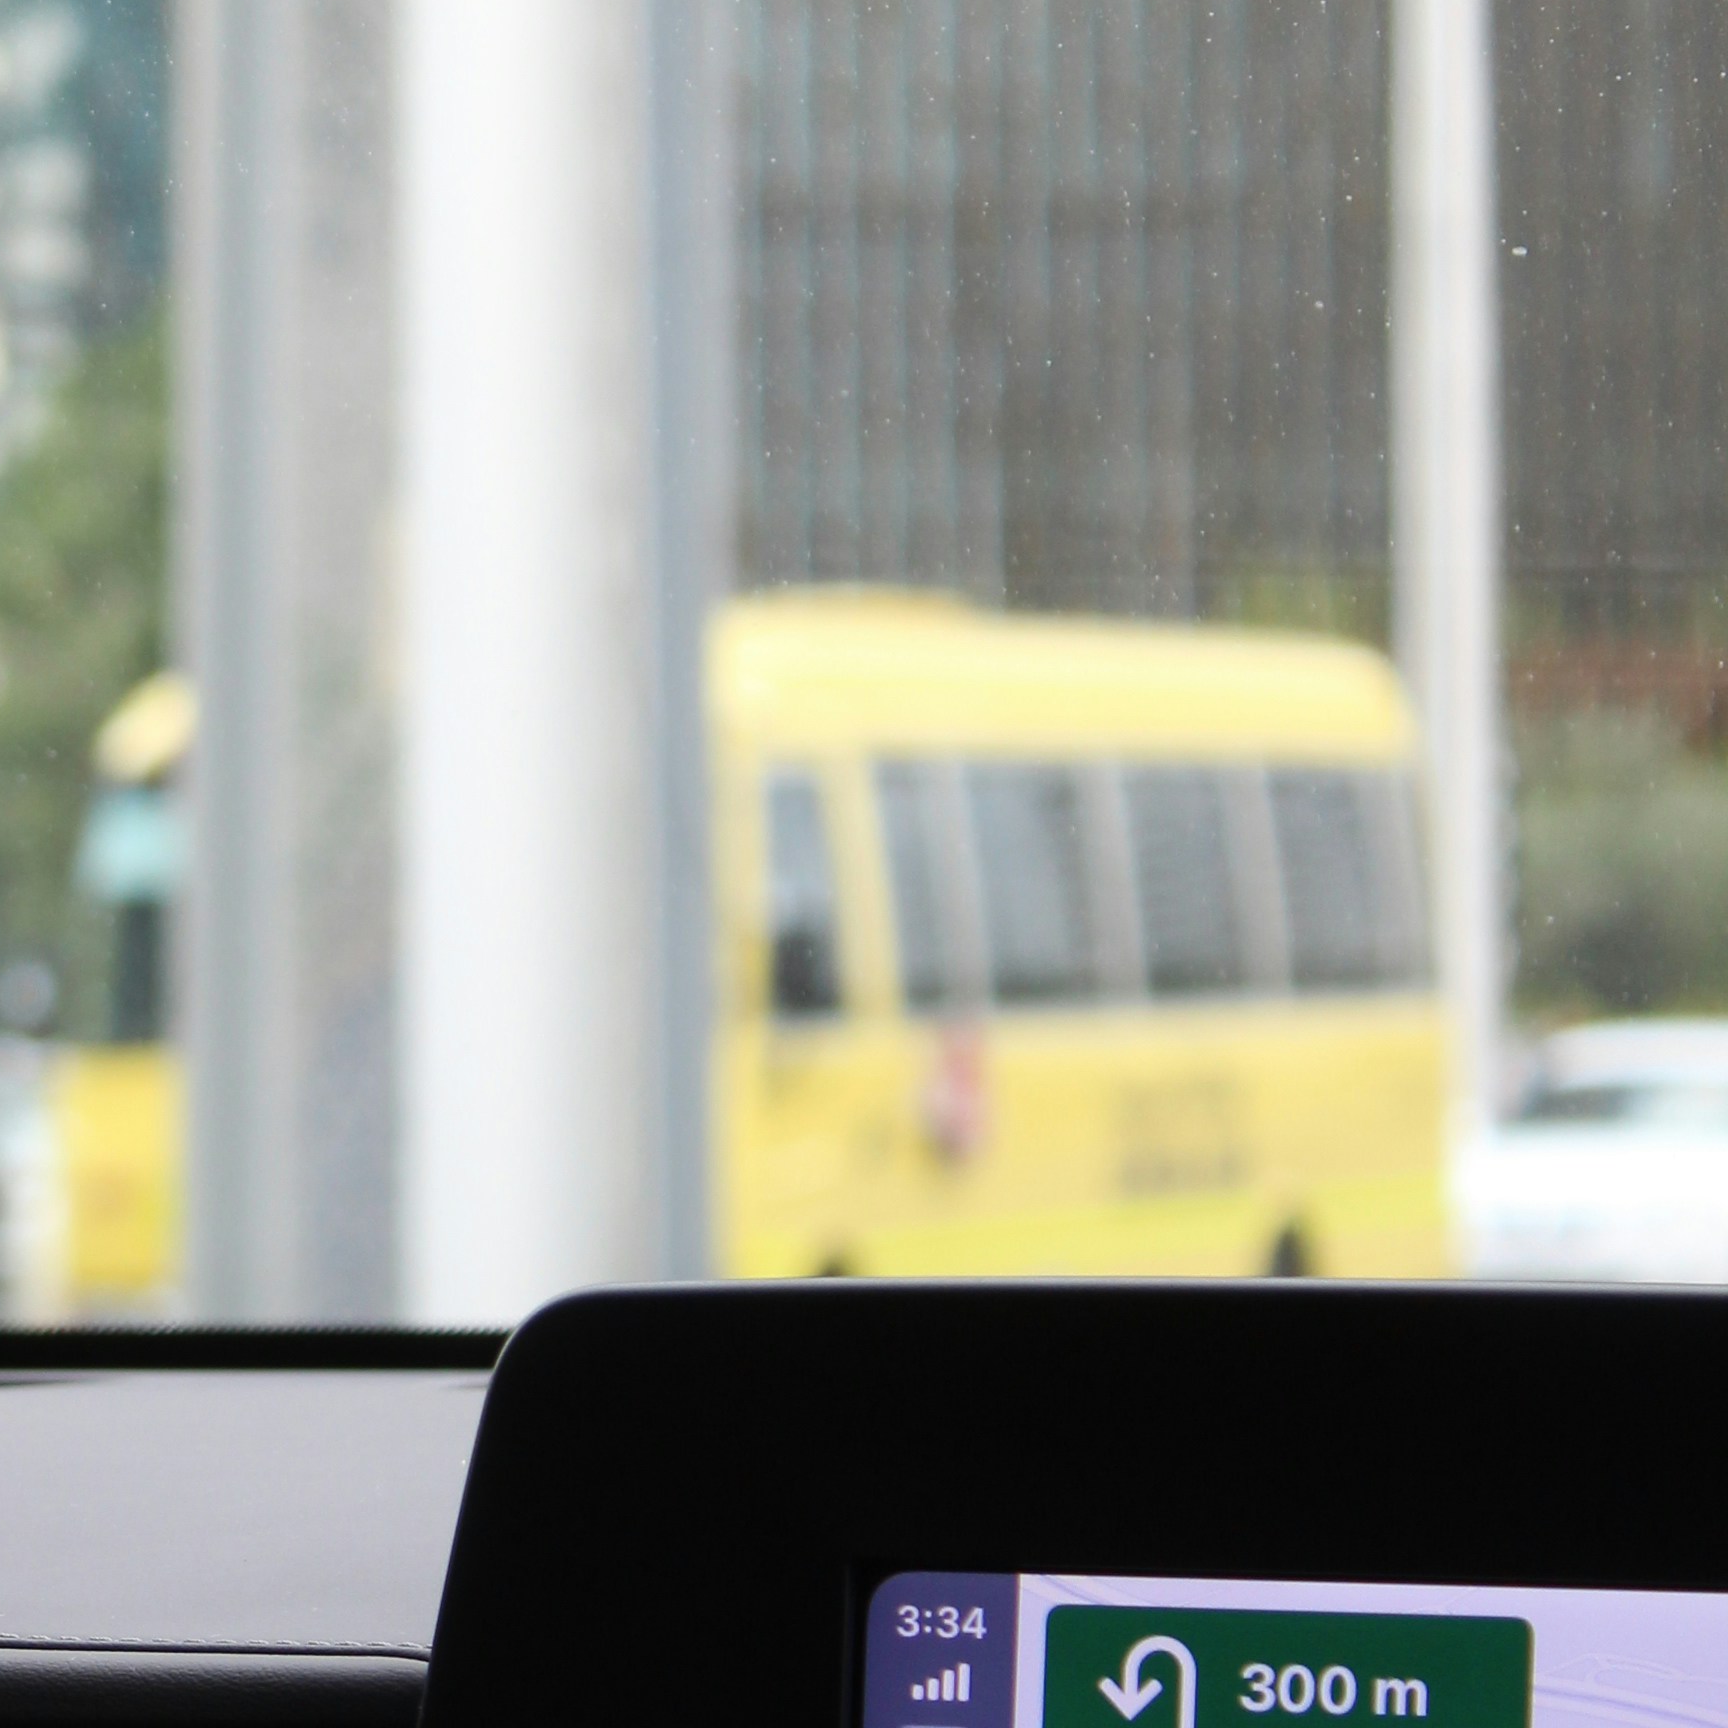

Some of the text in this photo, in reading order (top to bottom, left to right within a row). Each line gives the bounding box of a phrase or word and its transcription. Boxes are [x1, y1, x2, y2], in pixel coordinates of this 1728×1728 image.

[896, 1604, 987, 1640] 3:34
[1239, 1662, 1427, 1717] 300 m
